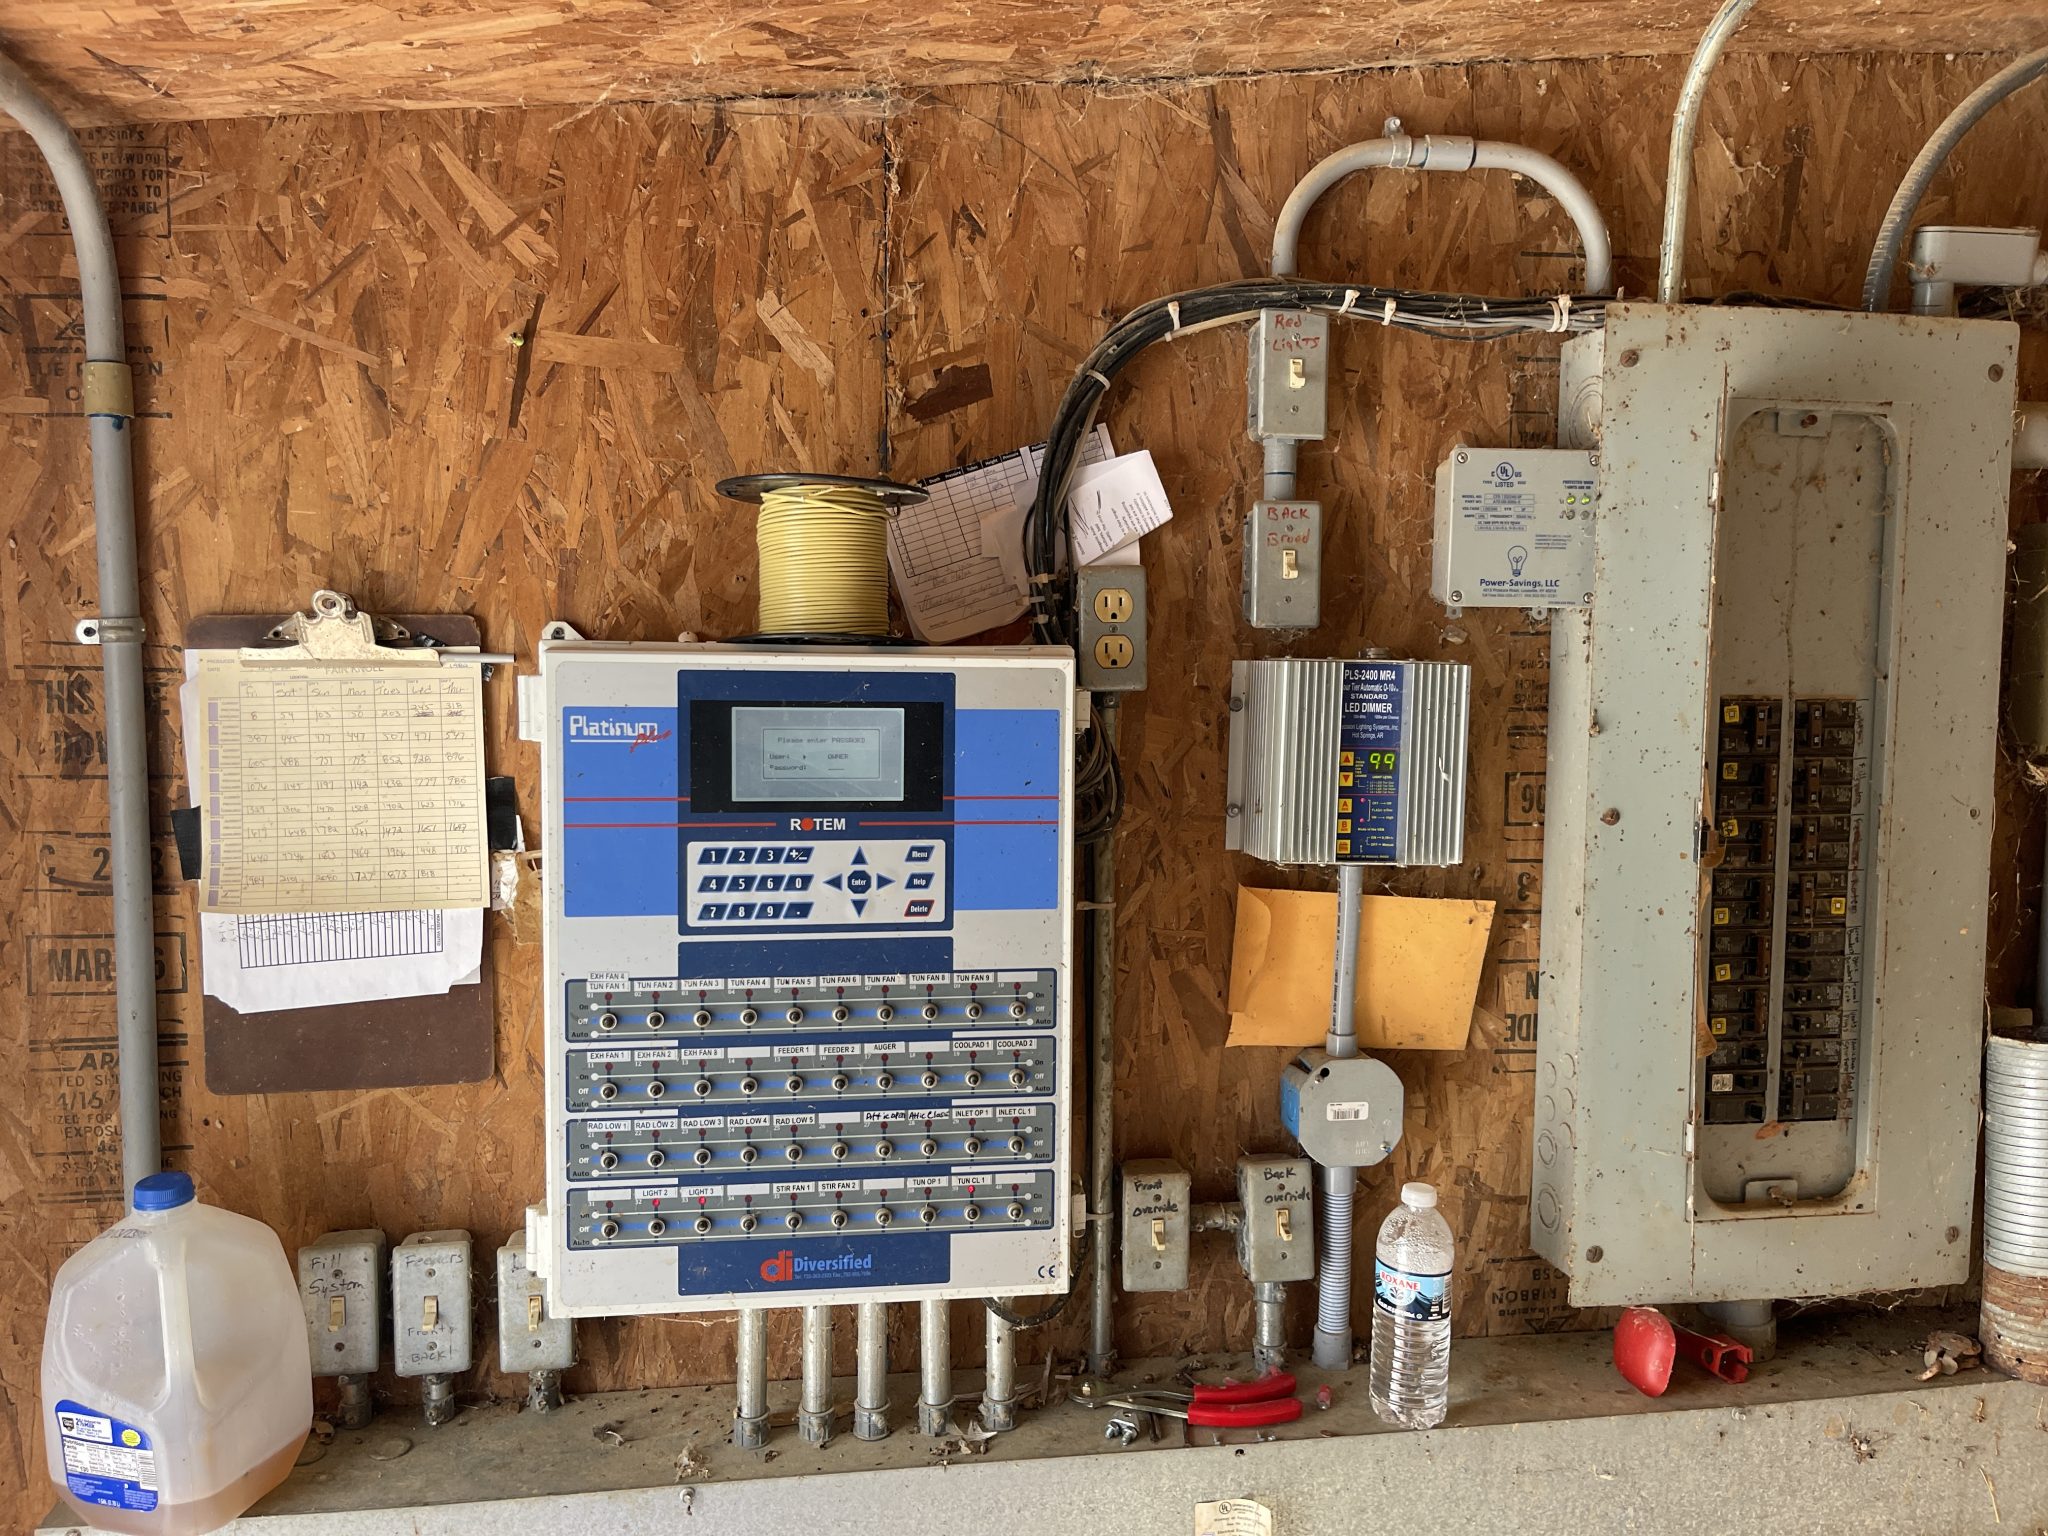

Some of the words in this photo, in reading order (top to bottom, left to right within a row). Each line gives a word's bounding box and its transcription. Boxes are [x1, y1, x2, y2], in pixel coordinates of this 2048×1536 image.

[142, 170, 164, 181] FOR
[146, 186, 161, 197] TO
[1275, 314, 1302, 330] Red
[1345, 669, 1378, 680] PLS-2400
[1380, 670, 1396, 680] MR4
[1360, 683, 1382, 691] Automatic
[1345, 702, 1360, 712] LED
[1361, 702, 1393, 713] DIMMER
[570, 715, 658, 736] Platinum
[710, 851, 716, 862] 1
[738, 851, 745, 862] 2
[767, 850, 774, 861] 3
[710, 878, 717, 890] 4
[738, 878, 745, 890] 5
[767, 878, 774, 889] 6
[795, 877, 802, 888] 0
[851, 878, 867, 886] Enter
[913, 878, 926, 886] Help
[710, 907, 716, 918] 7
[738, 906, 745, 917] 8
[767, 906, 774, 917] 9
[911, 905, 928, 913] Delete
[48, 948, 113, 983] MAR
[590, 972, 604, 981] EXH
[605, 972, 619, 981] FAN
[822, 976, 835, 984] TUN
[837, 975, 850, 984] FAN
[911, 974, 925, 983] TUN
[926, 974, 939, 982] FAN
[956, 974, 969, 983] TUN
[970, 974, 984, 982] FAN
[589, 982, 603, 991] TUN
[605, 982, 619, 990] FAN
[637, 981, 651, 990] TUN
[653, 980, 667, 990] FAN
[730, 979, 744, 988] TUN
[746, 978, 760, 987] FAN
[578, 1017, 588, 1025] Off
[873, 1042, 896, 1051] AUGER
[952, 1041, 985, 1049] COOLPAD
[995, 1040, 1028, 1048] COOLPAD
[777, 1047, 804, 1055] FEEDER
[823, 1046, 850, 1054] FEEDER
[590, 1051, 604, 1061] EXH
[605, 1051, 619, 1060] FAN
[637, 1051, 650, 1060] EXH
[652, 1050, 666, 1059] FAN
[578, 1087, 589, 1095] Off
[955, 1109, 973, 1118] INLET
[974, 1109, 983, 1117] OP
[998, 1108, 1016, 1116] INLET
[1017, 1107, 1026, 1115] CL
[587, 1122, 603, 1131] RAD
[604, 1121, 621, 1130] LOW
[634, 1120, 650, 1130] RAD
[652, 1120, 668, 1129] LOW
[683, 1119, 698, 1128] RAD
[699, 1118, 715, 1127] LOW
[912, 1178, 925, 1186] TUN
[926, 1178, 936, 1186] OP
[957, 1177, 970, 1185] TUN
[971, 1177, 980, 1185] CL
[776, 1185, 790, 1193] STIR
[792, 1184, 805, 1193] FAN
[821, 1182, 836, 1191] STIR
[837, 1182, 850, 1190] FAN
[642, 1188, 662, 1197] LIGHT
[688, 1188, 708, 1196] LIGHT
[793, 1254, 872, 1273] Diversified
[1380, 1270, 1420, 1291] ROXANE
[1492, 1287, 1557, 1304] RIBBON
